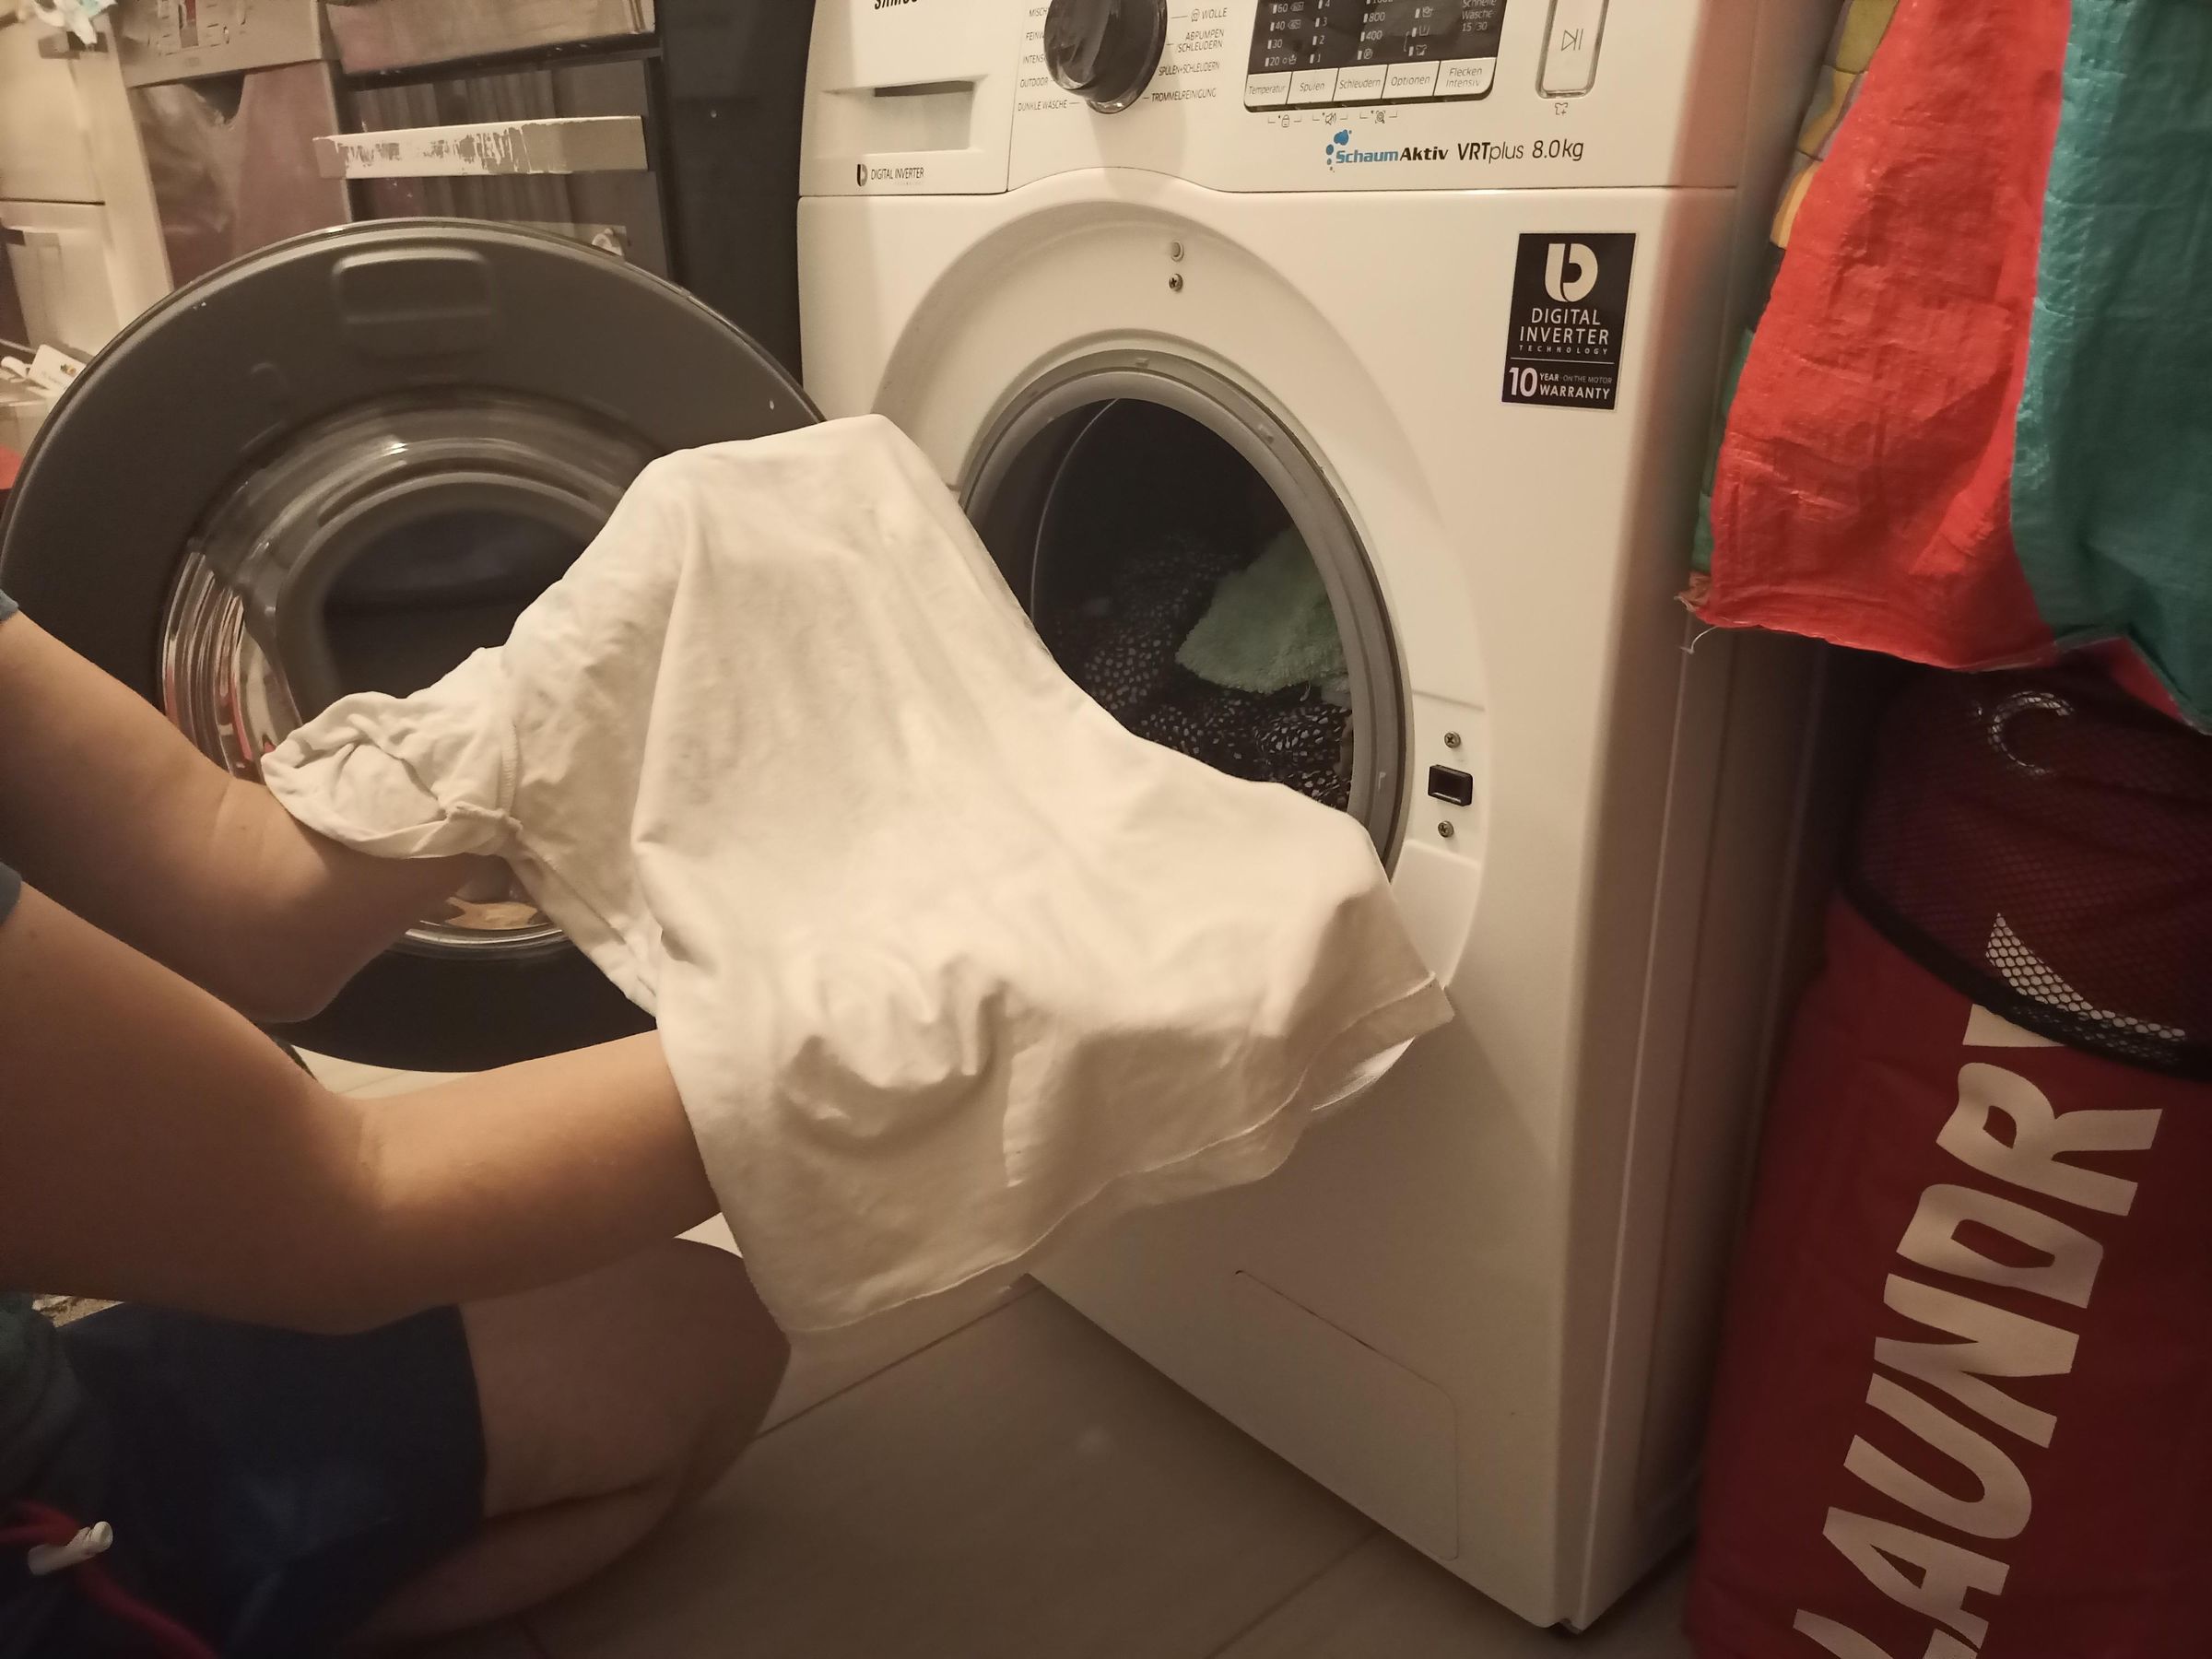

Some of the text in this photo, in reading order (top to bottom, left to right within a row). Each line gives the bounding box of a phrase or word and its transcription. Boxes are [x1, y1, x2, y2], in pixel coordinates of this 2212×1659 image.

[1202, 7, 1228, 19] WOLLE
[1277, 4, 1288, 13] 60
[1322, 18, 1327, 26] 3
[1369, 12, 1385, 22] 800
[1276, 21, 1286, 30] 40
[1185, 29, 1224, 41] ABPUMPEN
[1319, 35, 1324, 44] 2
[1366, 30, 1382, 41] 400
[1272, 39, 1283, 49] 30
[1269, 57, 1280, 66] 20
[1449, 67, 1483, 77] Flecken
[1020, 77, 1049, 88] OUTDOOR
[1338, 77, 1382, 90] Schleudern
[1391, 76, 1430, 88] Optionen
[1445, 78, 1480, 88] Intensiv
[1151, 88, 1218, 102] TROMMELREINIGUNG
[1248, 85, 1287, 95] Temperatur
[1018, 100, 1041, 112] DUNKLE
[1457, 141, 1524, 164] VRTplus
[870, 167, 924, 180] DIGITAL INVERTER
[1531, 307, 1601, 326] DIGITAL
[1519, 325, 1609, 346] INVERTER
[1519, 345, 1608, 355] TECHNOLOGY
[1508, 367, 1538, 398] 10
[1539, 372, 1559, 382] YEAR
[1573, 375, 1587, 383] THE
[1587, 376, 1613, 384] MOTOR
[1539, 383, 1611, 400] WARRANTY
